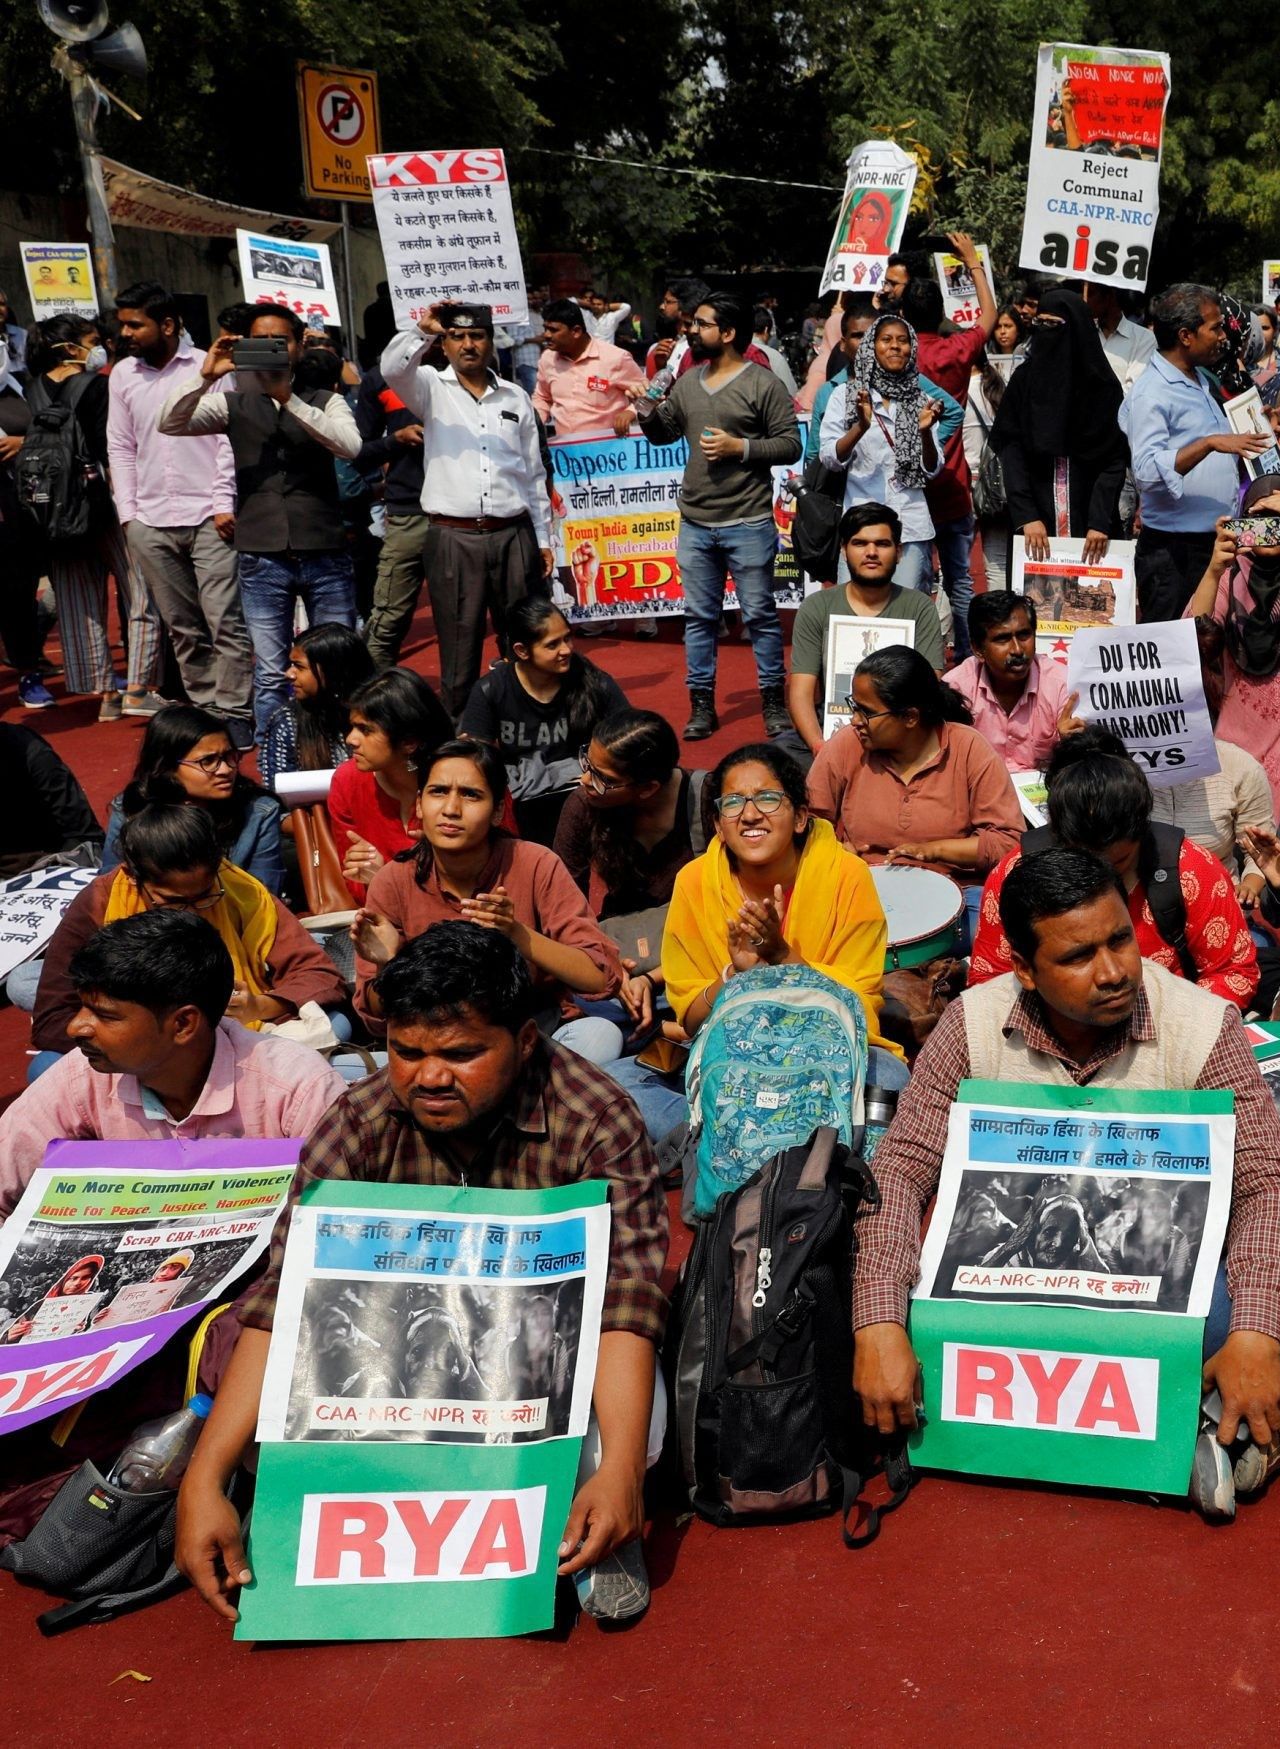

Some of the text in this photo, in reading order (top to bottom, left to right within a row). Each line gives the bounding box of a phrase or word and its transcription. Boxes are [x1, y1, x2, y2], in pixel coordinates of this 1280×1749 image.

[335, 154, 352, 169] No
[373, 151, 501, 186] KYS
[1083, 159, 1128, 179] Reject
[322, 168, 370, 190] Parking
[1063, 180, 1143, 203] Communal
[401, 187, 425, 202] जलते
[442, 189, 453, 200] घर
[456, 186, 484, 199] किसके
[1047, 198, 1153, 226] CAA-NPR-NRC
[398, 237, 432, 250] तकसीम
[436, 236, 446, 248] के
[493, 231, 501, 244] में
[1040, 225, 1149, 282] aisa
[554, 434, 687, 487] Oppose Hind
[570, 486, 590, 509] चलो
[620, 480, 666, 504] रामलीला
[567, 518, 676, 542] Young India against
[607, 536, 678, 559] Hyderabad
[1099, 641, 1161, 674] DU FOR
[1089, 677, 1184, 711] COMMUNAL
[969, 1117, 1161, 1142] साम्प्रदायिक हिंसा के खिलाफ
[1016, 1145, 1210, 1171] संविधान हमले के खिलाफ!
[55, 1173, 293, 1194] No More Communal Violence!
[39, 1193, 280, 1217] Unite for Peace. Justice. Harmony!
[123, 1221, 262, 1247] Scrap CAA-NRC-NPR!
[958, 1271, 1150, 1296] CAA-NRC-NPR रद्द करो!!
[955, 1349, 1141, 1433] RYA
[313, 1498, 528, 1579] RYA
